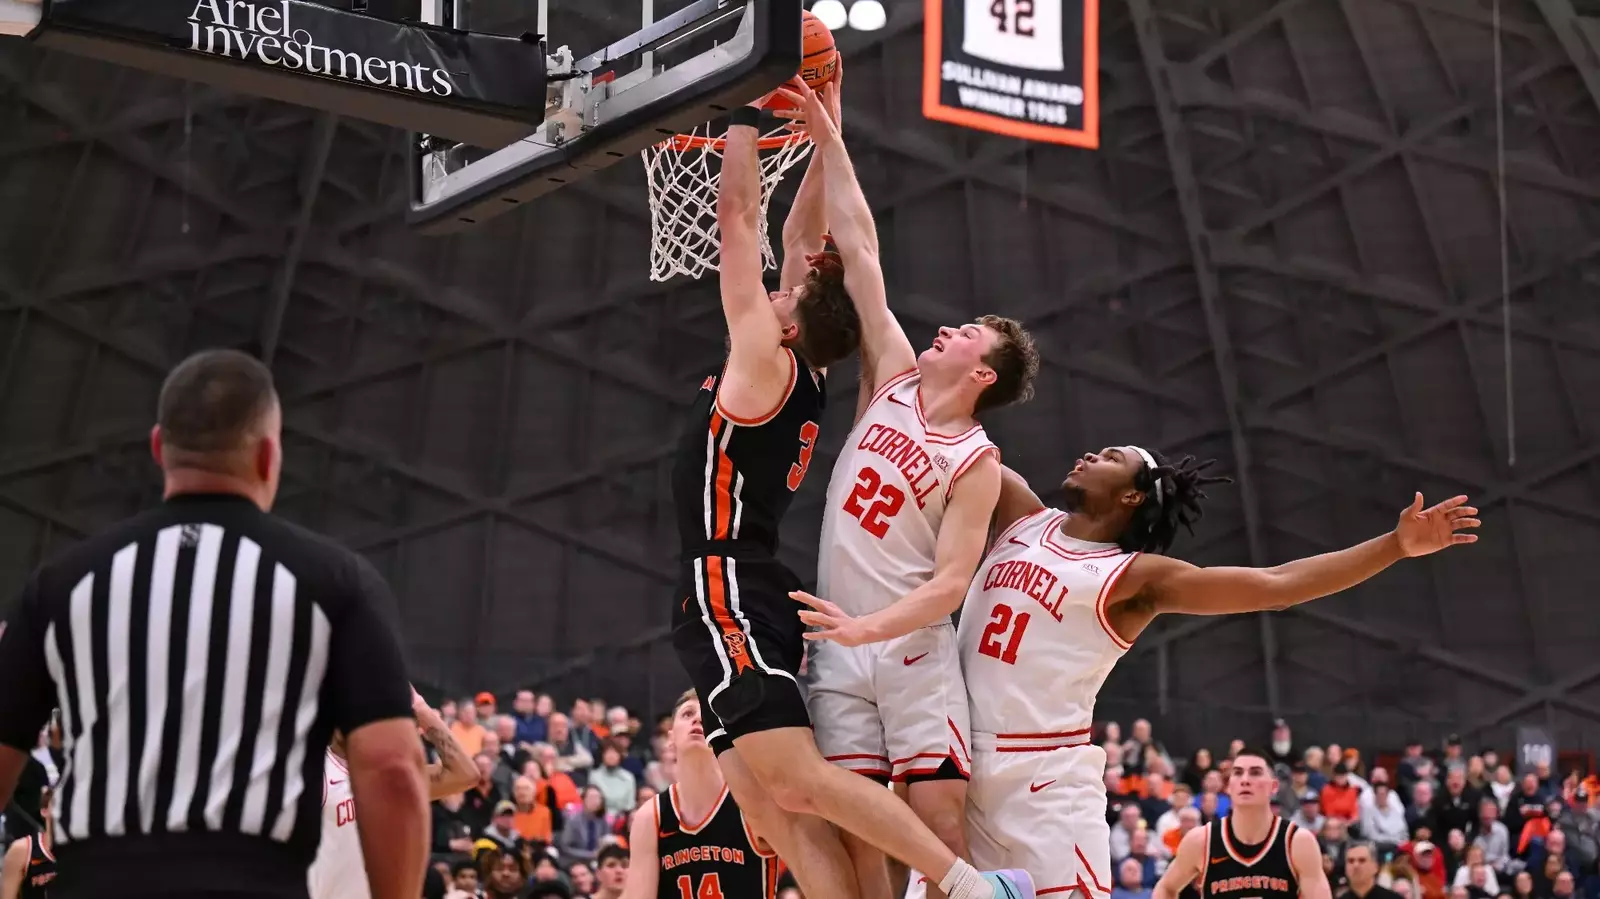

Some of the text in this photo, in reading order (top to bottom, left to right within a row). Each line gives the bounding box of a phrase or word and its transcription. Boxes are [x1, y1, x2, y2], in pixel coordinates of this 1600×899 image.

[186, 0, 293, 39] Ariel
[990, 0, 1034, 37] 42
[942, 60, 1083, 106] SULLIVAN AWARD
[958, 85, 1025, 119] WINNER
[786, 420, 819, 492] 3
[857, 423, 940, 511] CORNELL
[842, 466, 906, 540] 22
[983, 560, 1069, 623] CORNELL
[978, 603, 1031, 665] 21
[677, 872, 725, 899] 14
[1210, 875, 1289, 895] PRINCETON
